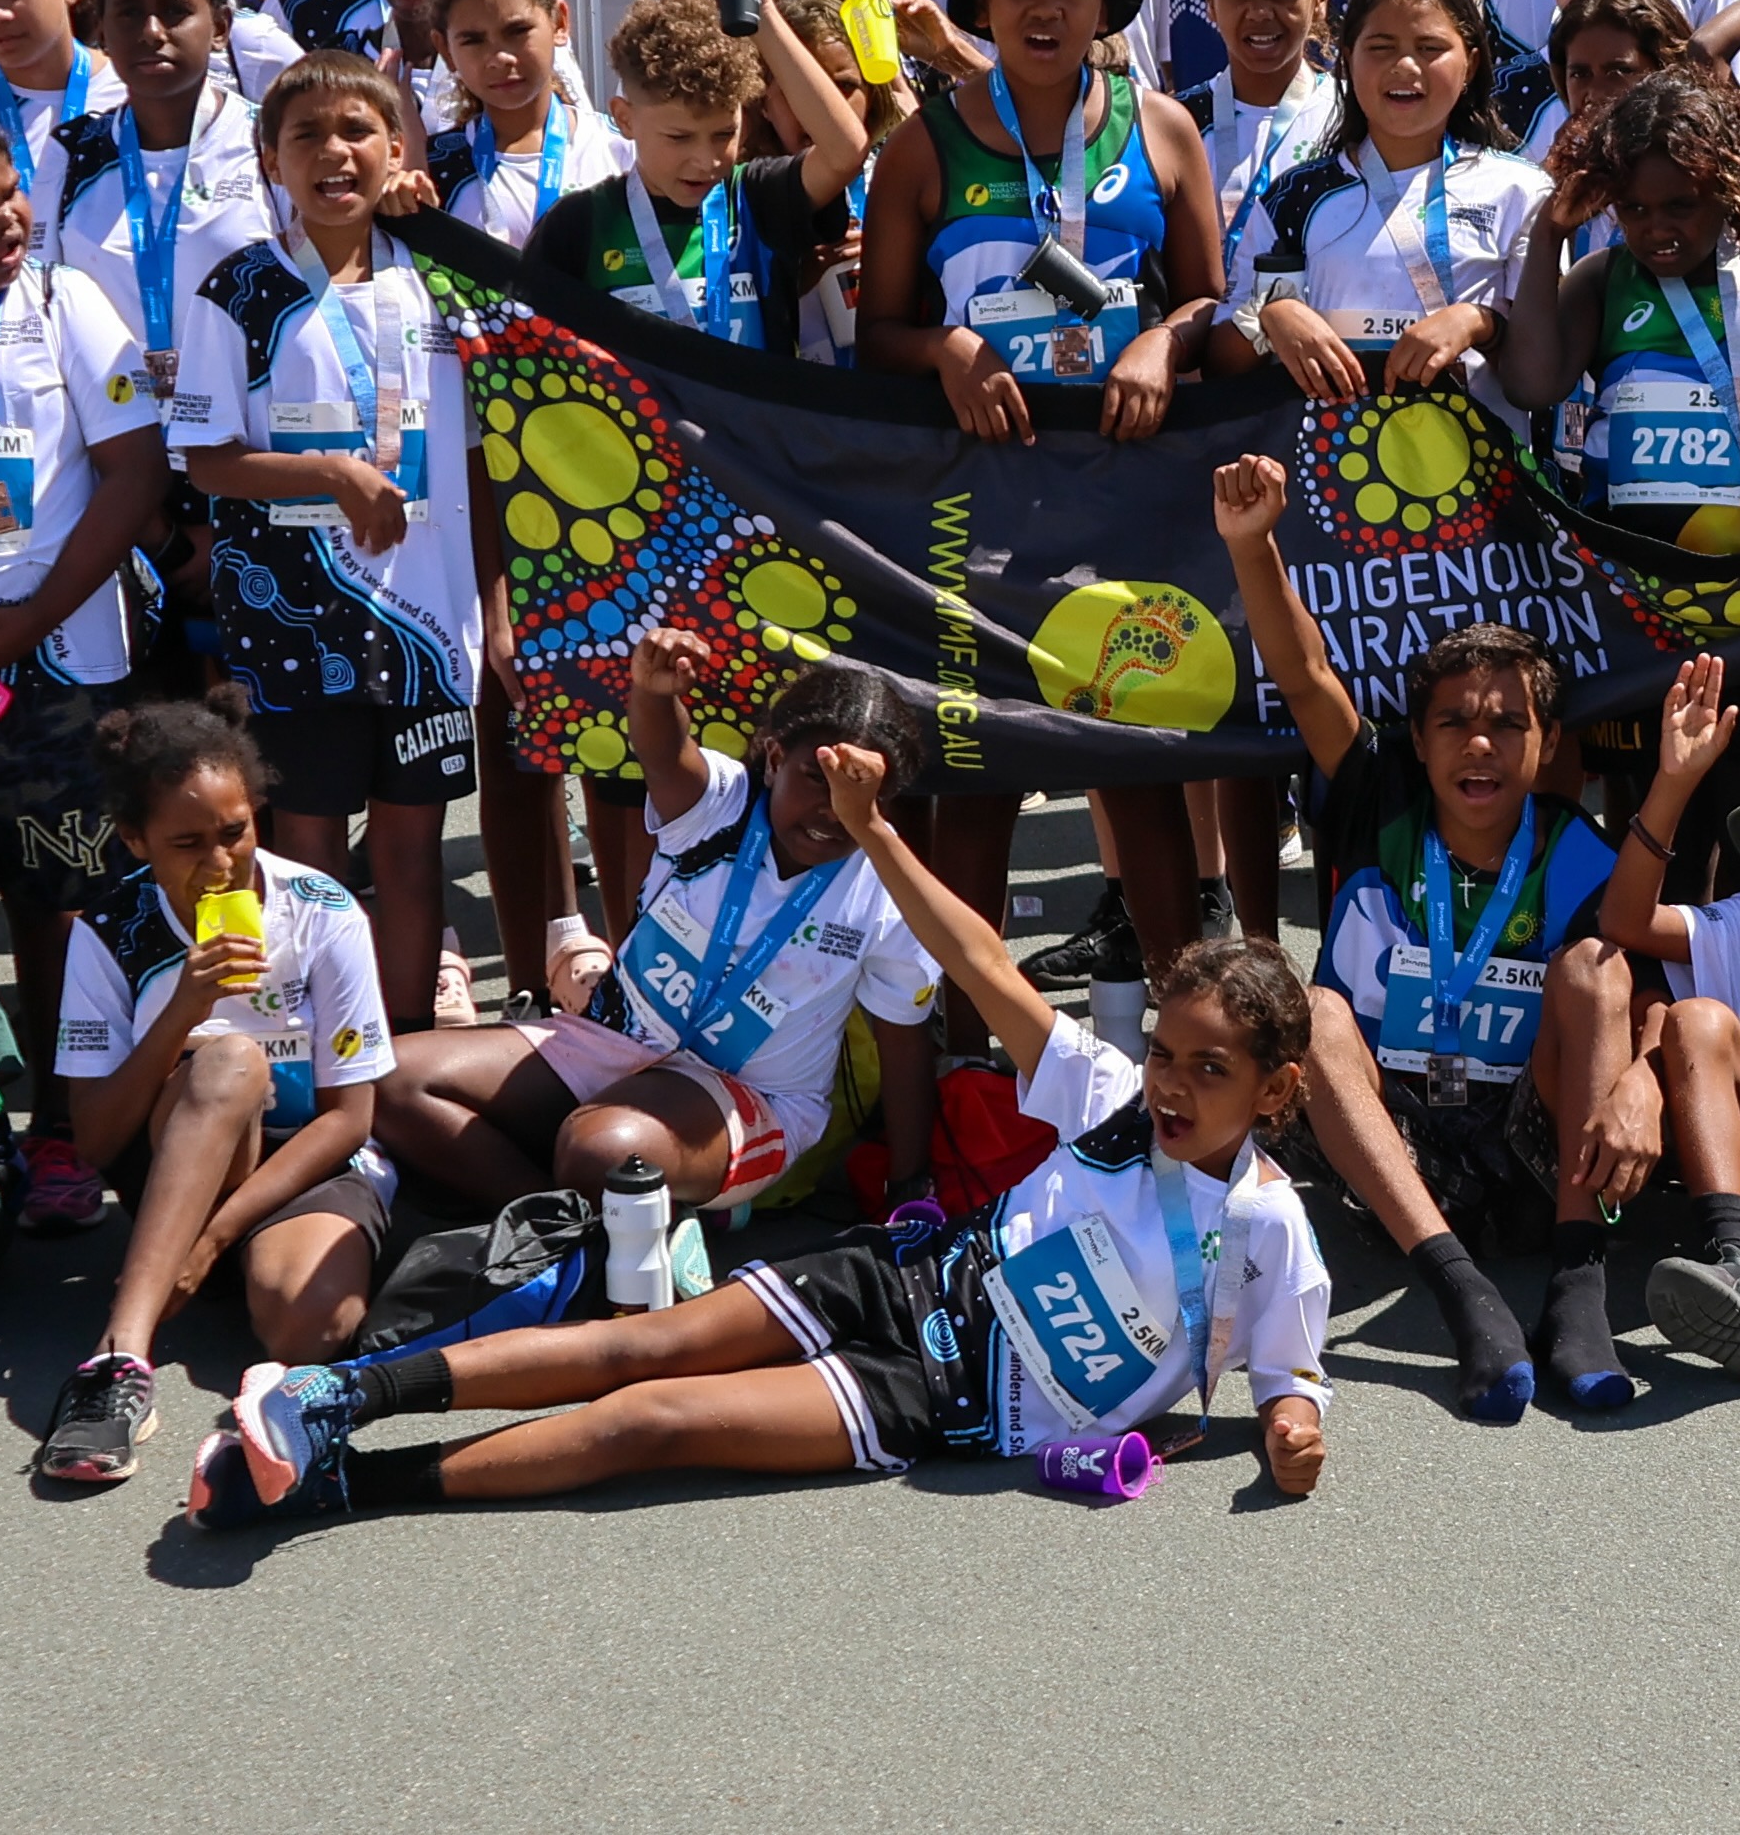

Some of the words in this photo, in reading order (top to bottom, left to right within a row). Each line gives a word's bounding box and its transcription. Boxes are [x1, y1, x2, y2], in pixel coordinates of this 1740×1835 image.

[1008, 325, 1104, 373] 271
[1631, 427, 1732, 467] 2782
[444, 757, 465, 772] USA
[16, 808, 112, 877] NY
[642, 953, 736, 1047] 262
[1031, 1272, 1124, 1386] 2724
[1118, 1305, 1169, 1361] 2.5KM
